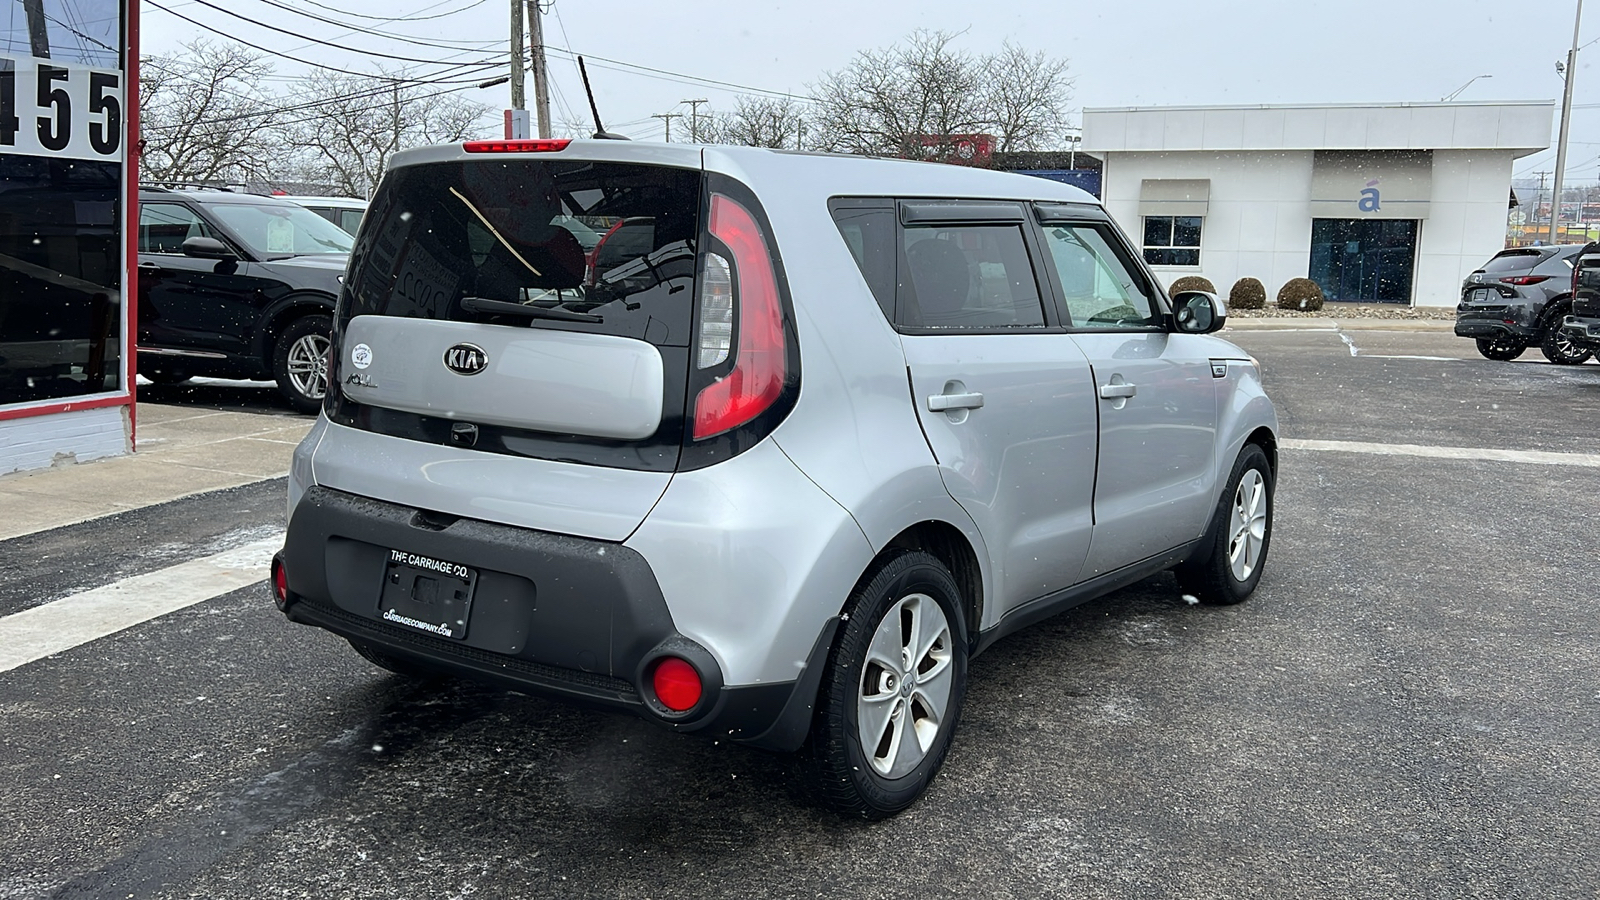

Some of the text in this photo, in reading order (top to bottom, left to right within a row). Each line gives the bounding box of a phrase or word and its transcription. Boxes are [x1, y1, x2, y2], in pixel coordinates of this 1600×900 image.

[448, 348, 479, 370] KIA
[391, 549, 469, 578] THE CARRIAGE CO.
[383, 611, 452, 637] CARRIAGECOMPANY.COM
